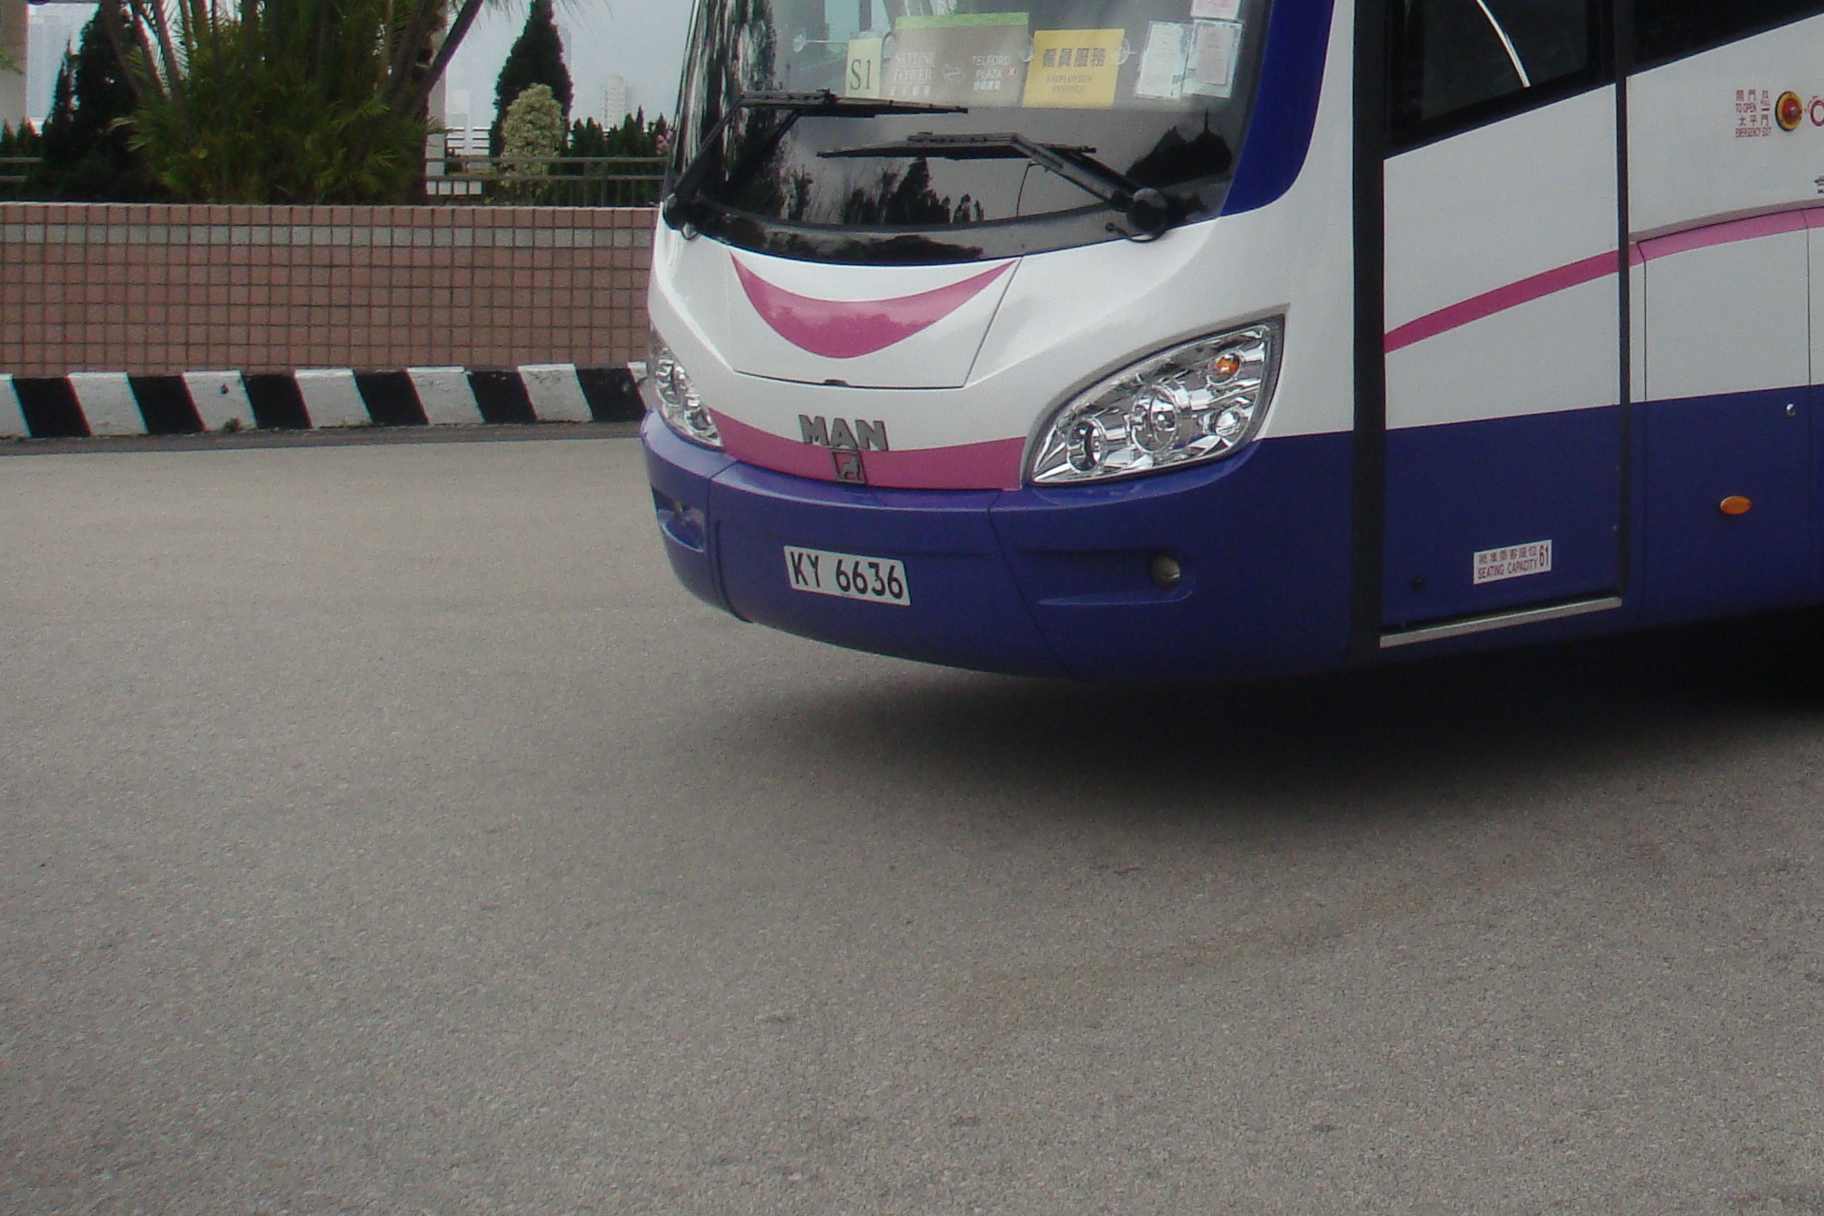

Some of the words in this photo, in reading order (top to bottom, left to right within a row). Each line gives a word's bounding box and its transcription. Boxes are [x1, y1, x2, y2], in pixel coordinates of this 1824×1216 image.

[850, 58, 871, 90] S1
[798, 414, 889, 452] MAN
[1478, 564, 1505, 580] SEATING
[1507, 559, 1538, 575] CAPACITY
[1539, 545, 1549, 567] 61
[790, 550, 820, 588] KY
[836, 558, 904, 599] 6636
